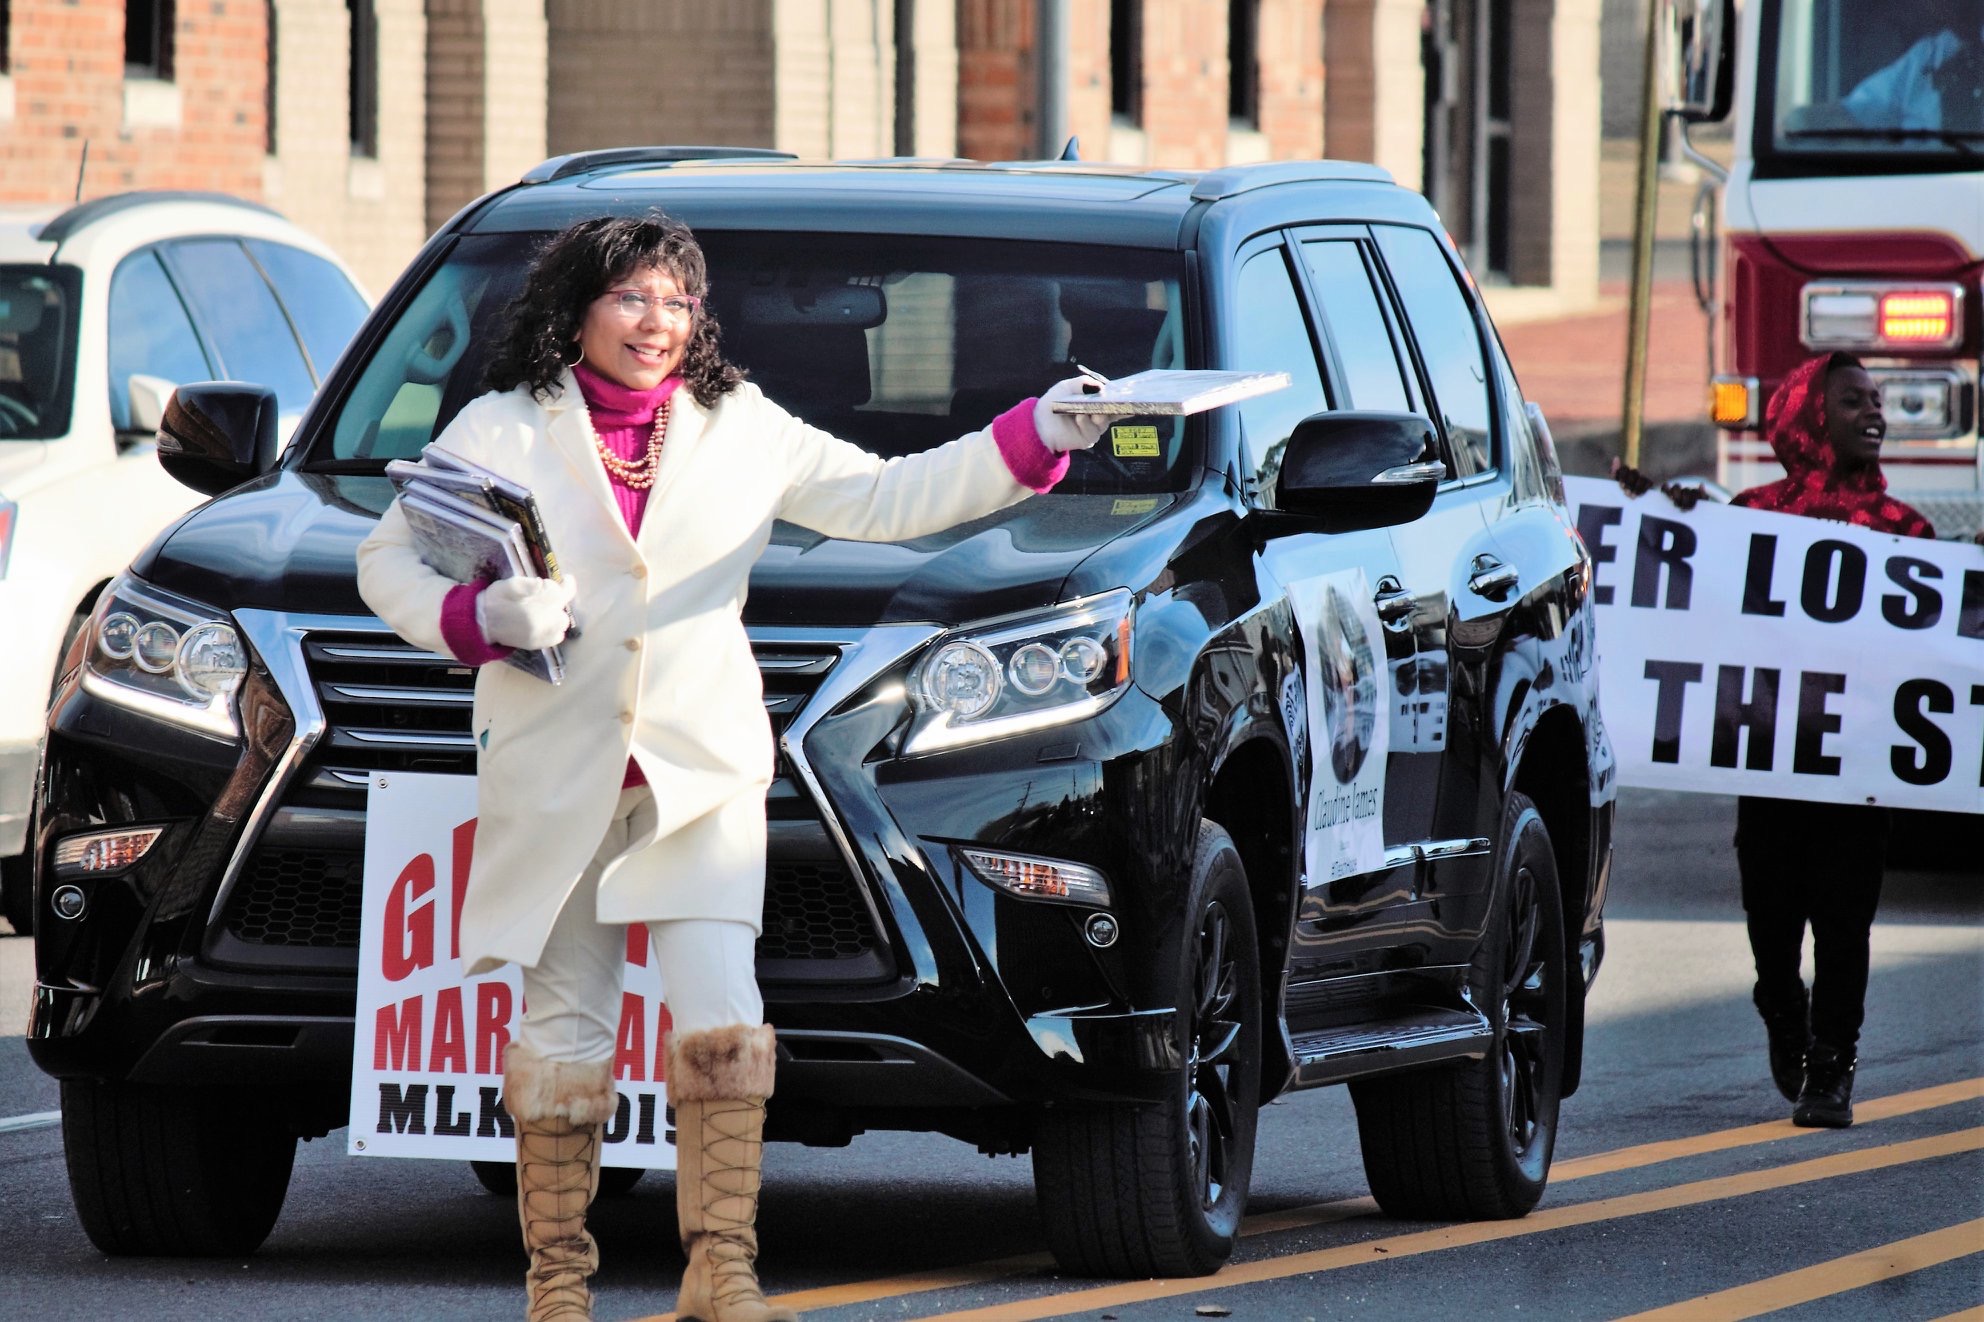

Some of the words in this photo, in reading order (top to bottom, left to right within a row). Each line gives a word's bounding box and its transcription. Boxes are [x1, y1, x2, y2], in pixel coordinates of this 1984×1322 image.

[1643, 658, 1847, 777] THE
[373, 981, 674, 1083] MARA
[376, 1083, 516, 1138] MLK
